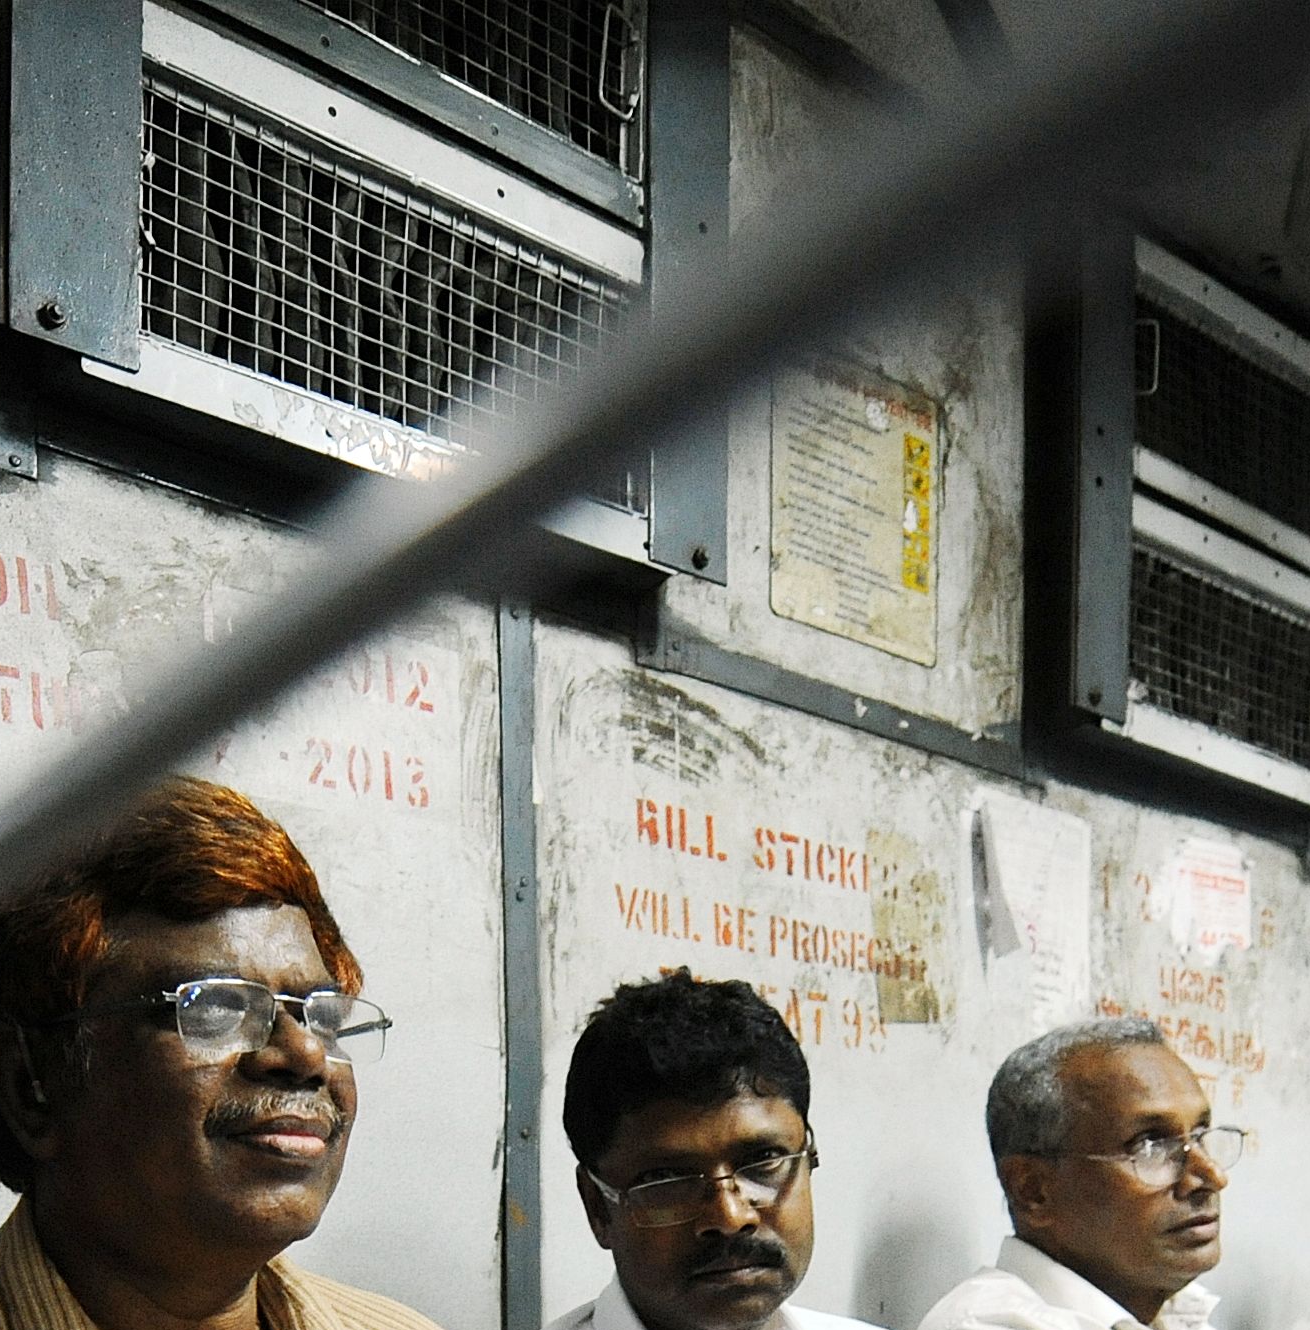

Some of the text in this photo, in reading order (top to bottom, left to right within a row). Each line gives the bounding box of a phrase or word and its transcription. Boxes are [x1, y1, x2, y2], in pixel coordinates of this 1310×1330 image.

[319, 649, 435, 713] 012
[305, 737, 430, 808] 2013
[635, 798, 728, 862] BILL
[614, 883, 701, 942] WILL
[713, 902, 756, 953] BE
